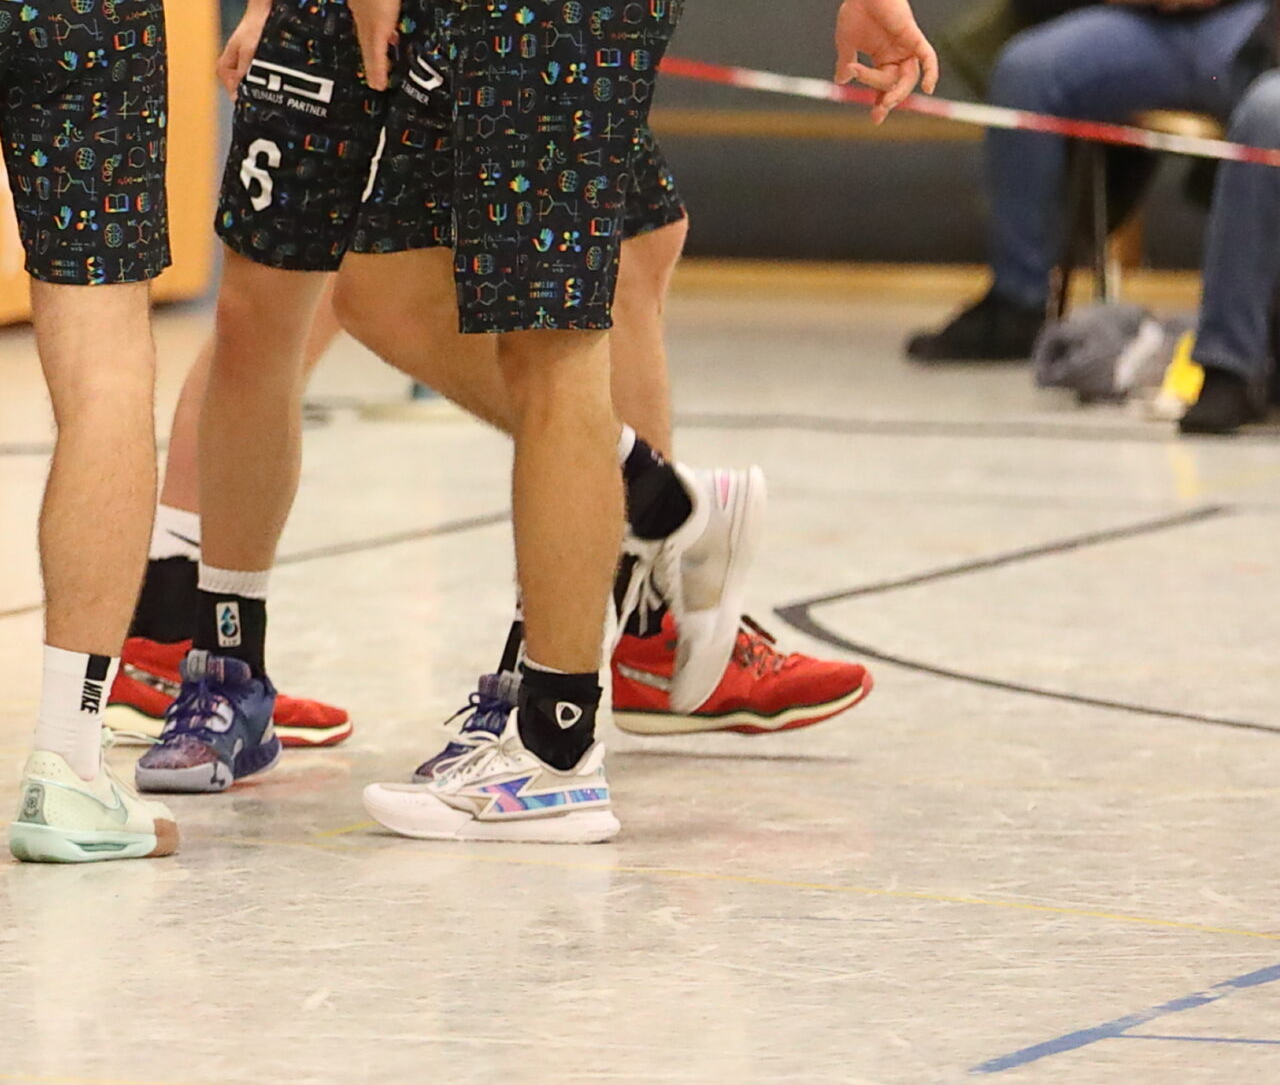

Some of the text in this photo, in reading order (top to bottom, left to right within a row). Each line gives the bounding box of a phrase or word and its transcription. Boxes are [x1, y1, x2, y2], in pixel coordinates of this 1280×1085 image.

[286, 98, 328, 118] PARTNER
[239, 138, 282, 212] 6
[80, 681, 103, 714] NIKE
